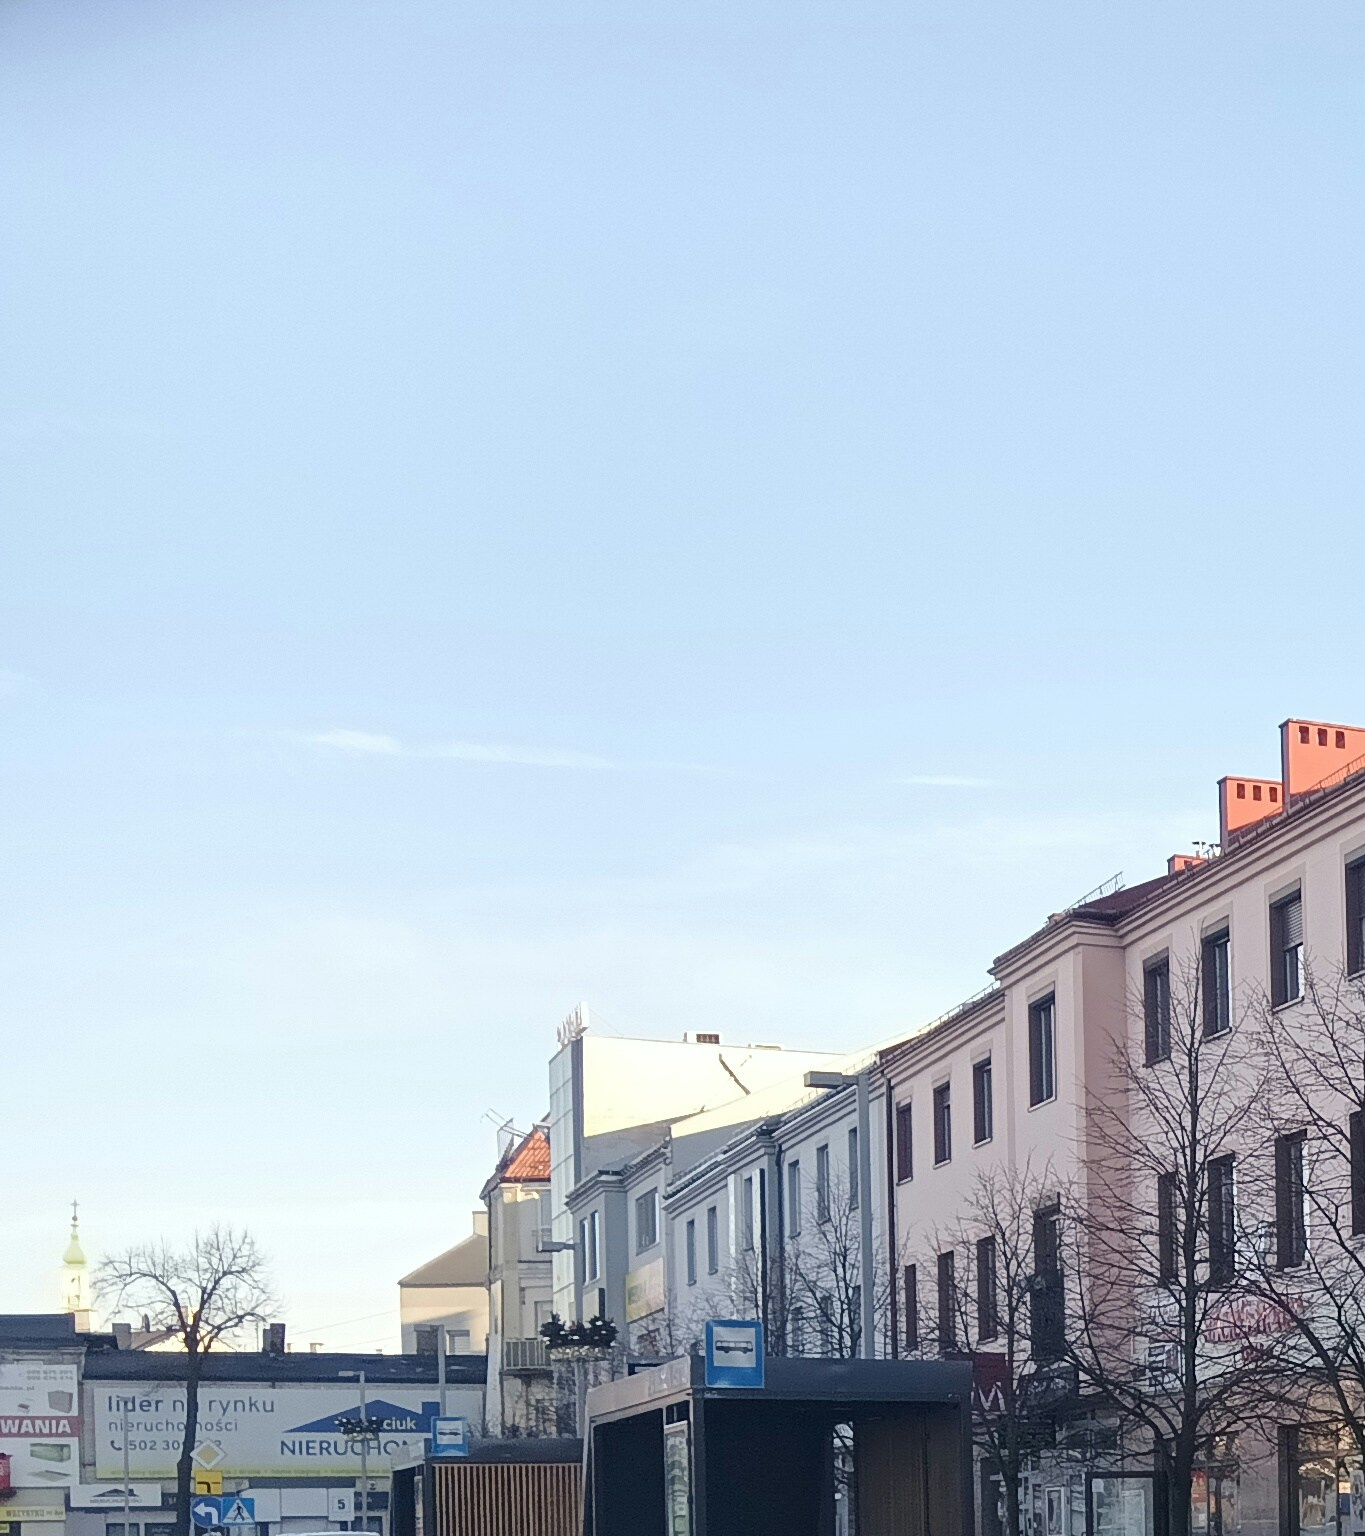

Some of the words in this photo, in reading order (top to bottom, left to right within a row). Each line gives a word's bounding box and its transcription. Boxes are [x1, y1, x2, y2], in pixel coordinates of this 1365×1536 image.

[108, 1395, 163, 1413] lider
[209, 1396, 275, 1417] rynku
[1, 1420, 71, 1434] WANIA
[128, 1440, 156, 1450] 502
[162, 1440, 184, 1450] 30
[337, 1499, 346, 1510] 5
